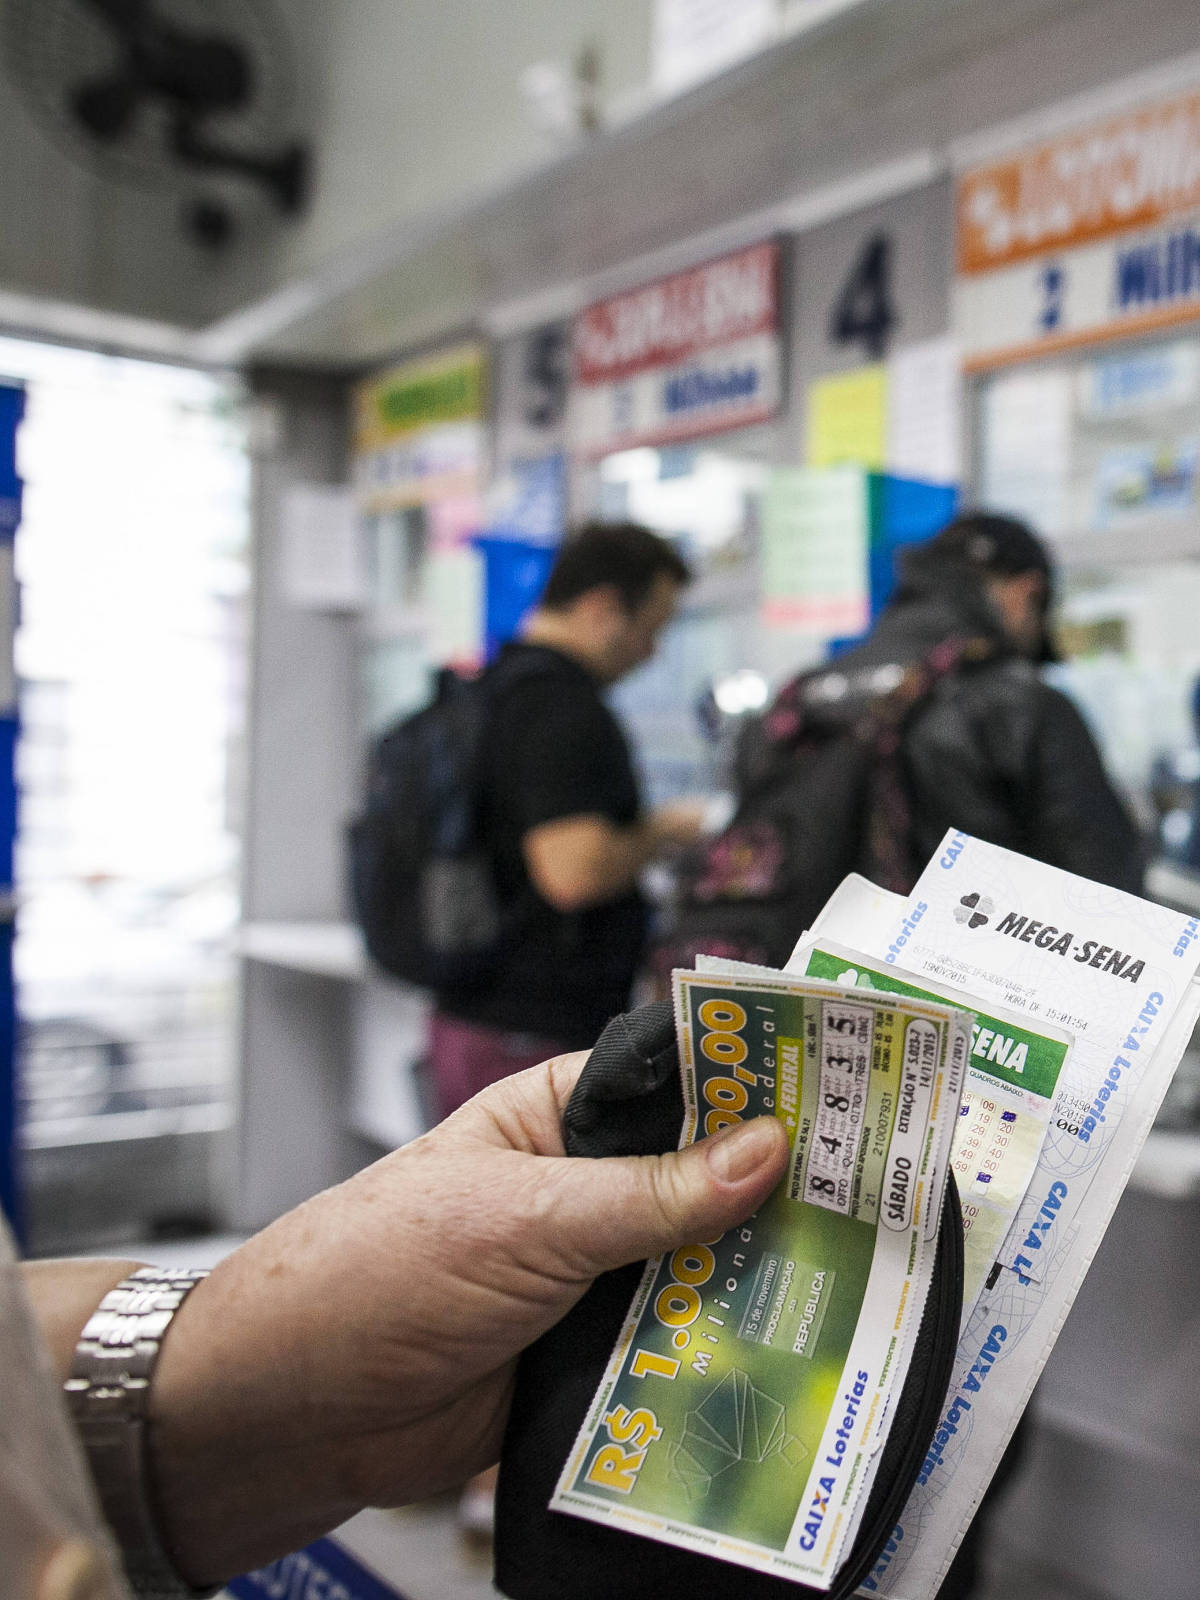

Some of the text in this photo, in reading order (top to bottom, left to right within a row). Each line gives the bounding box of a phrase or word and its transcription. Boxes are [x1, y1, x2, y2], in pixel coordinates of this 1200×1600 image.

[828, 234, 892, 354] 4
[1040, 266, 1065, 333] 2
[884, 900, 928, 964] oterias
[995, 911, 1146, 984] MEGA-SENA
[780, 1045, 798, 1112] FEDERAL
[919, 1032, 936, 1087] 14/11/2015
[1078, 991, 1164, 1143] CAIXA Loterias
[809, 1015, 855, 1194] 8 4 8 3 5
[897, 1083, 915, 1133] EXTRAÇÃO
[864, 1091, 892, 1207] 21 210007931
[691, 1005, 775, 1377] Milioná ederal
[883, 1157, 911, 1221] SÁBADO
[1023, 1181, 1068, 1250] CAIXA
[744, 1259, 780, 1336] 15 de novembro
[792, 1271, 824, 1353] REPÚBLICA
[962, 1325, 1007, 1393] CAIXA
[584, 1403, 663, 1495] R$
[799, 1371, 867, 1550] CAIXA Loterias
